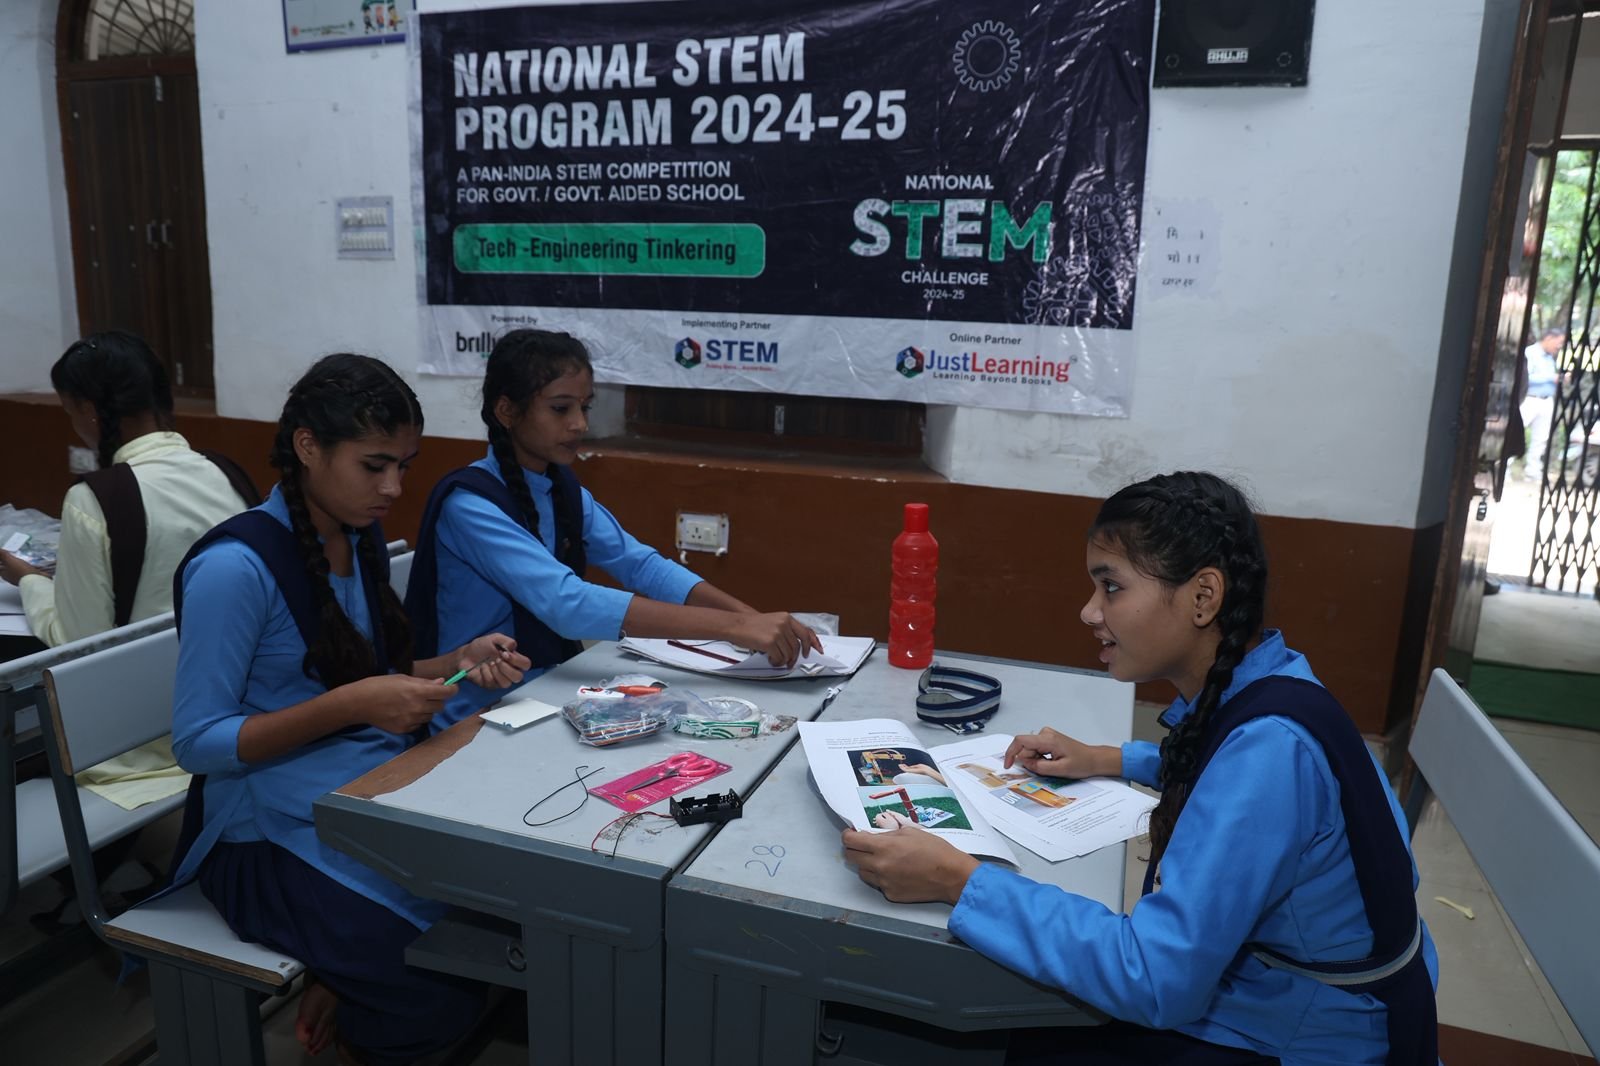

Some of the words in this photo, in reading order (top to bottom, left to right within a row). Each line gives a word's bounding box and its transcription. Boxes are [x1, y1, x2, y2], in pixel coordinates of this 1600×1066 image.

[453, 42, 657, 98] NATIONAL
[672, 32, 805, 87] STEM
[1207, 50, 1248, 63] AHUJA
[455, 98, 672, 150] PROGRAM
[690, 90, 907, 145] 2024-25
[456, 167, 469, 182] A
[471, 164, 553, 182] PAN-INDIA
[556, 162, 602, 180] STEM
[606, 160, 731, 179] COMPETITION
[905, 174, 994, 190] NATIONAL
[456, 187, 490, 203] FOR
[493, 186, 541, 203] GOVT.
[554, 185, 604, 202] GOVT.
[608, 184, 662, 201] AIDED
[666, 183, 745, 201] SCHOOL
[849, 198, 1053, 262] STEM
[478, 237, 516, 258] Tech
[644, 238, 736, 265] Tinkering
[901, 270, 989, 285] CHALLENGE
[923, 288, 965, 300] 2024-25
[491, 314, 525, 323] Powered
[527, 315, 538, 326] by
[681, 318, 738, 330] Implementing
[740, 320, 771, 330] Partner
[949, 332, 982, 344] Online
[984, 334, 1022, 346] Partner
[706, 339, 779, 364] STEM
[932, 371, 976, 382] Learning
[980, 374, 1017, 384] Beyond
[1021, 376, 1052, 386] Books
[744, 844, 786, 878] 28
